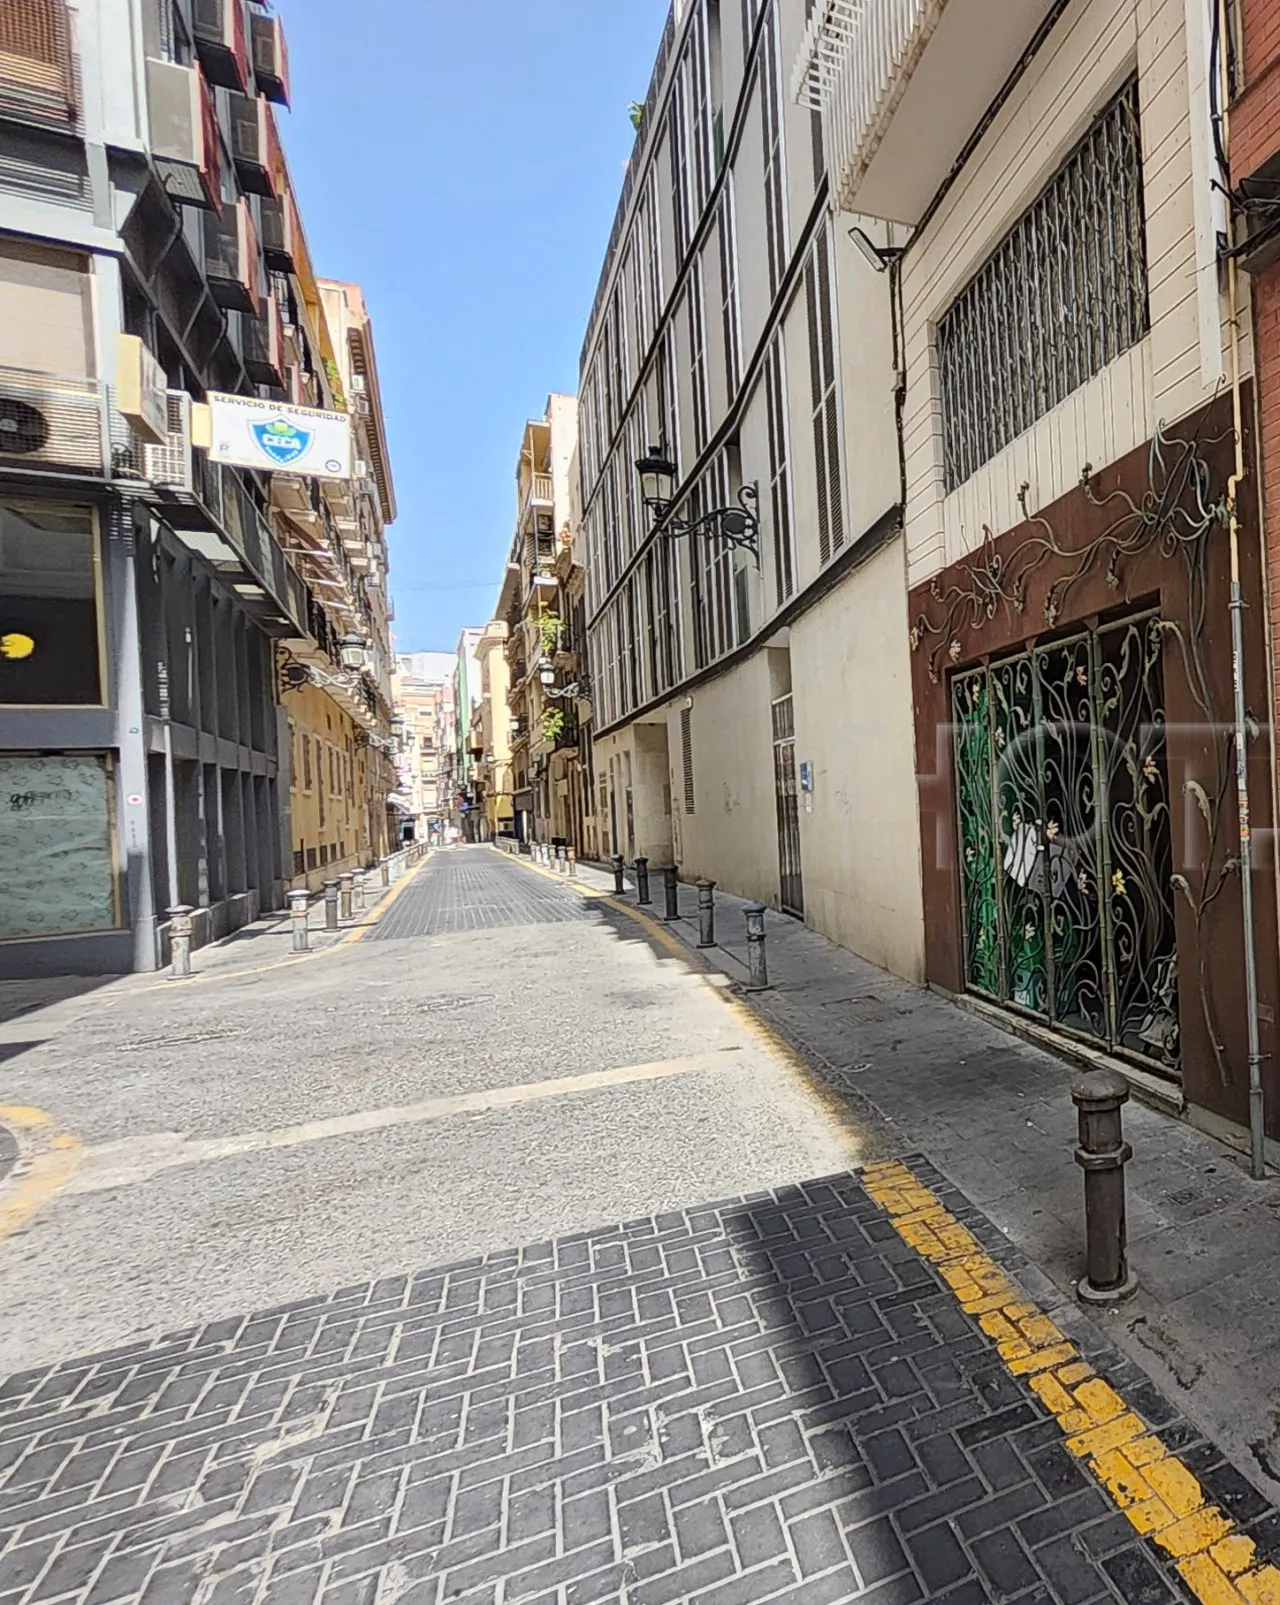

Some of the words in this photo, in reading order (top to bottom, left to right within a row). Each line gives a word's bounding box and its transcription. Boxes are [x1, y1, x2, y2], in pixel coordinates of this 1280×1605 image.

[213, 395, 266, 410] SERVICIO
[268, 403, 284, 412] DE
[286, 406, 347, 423] SEGURIDAD
